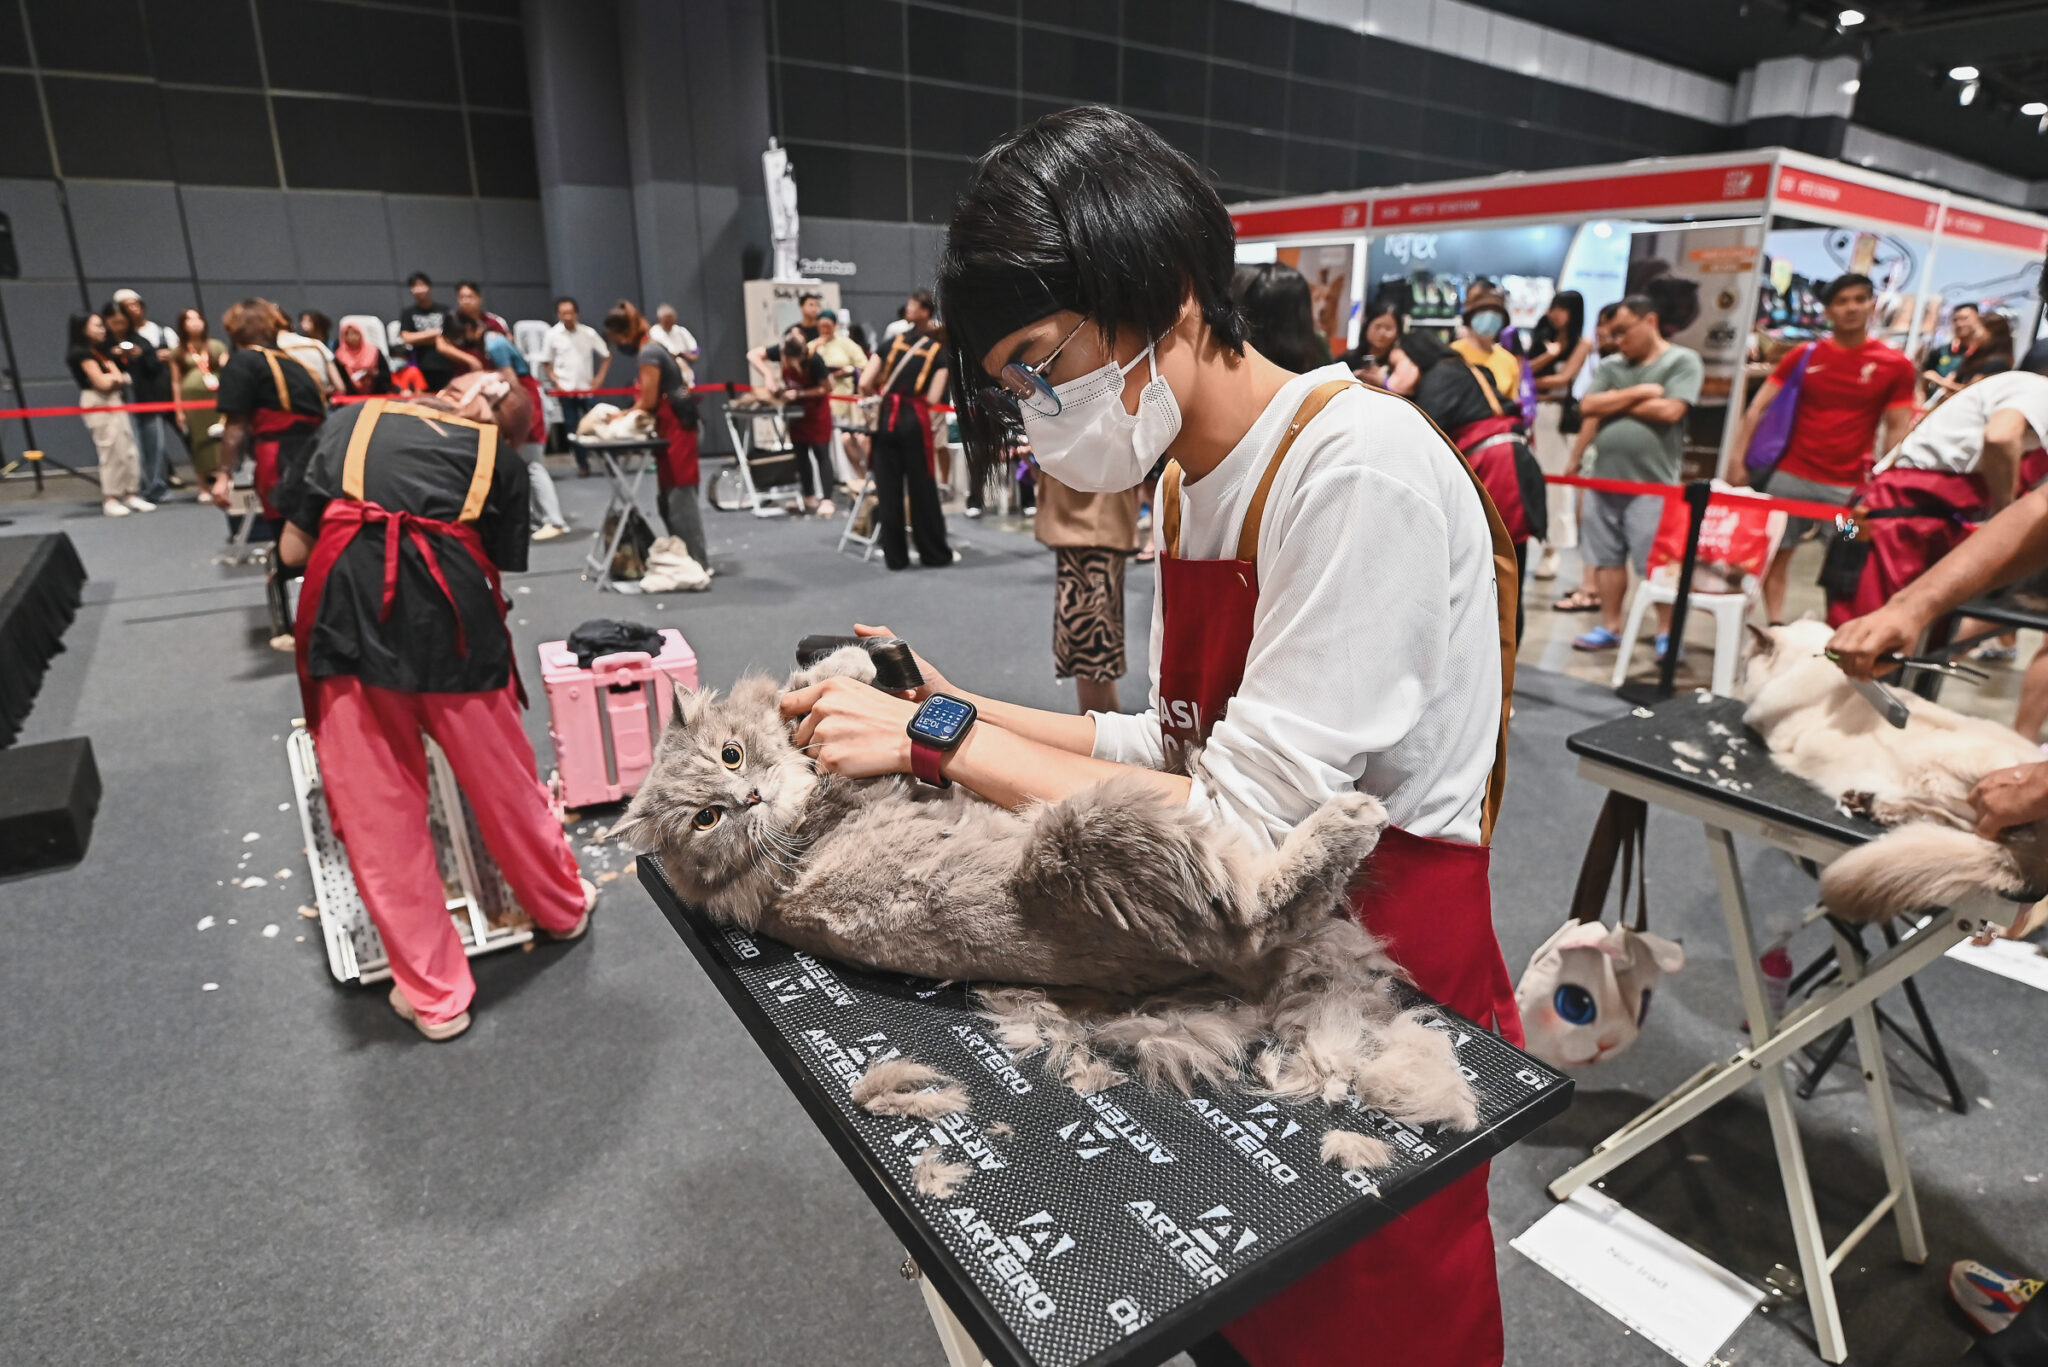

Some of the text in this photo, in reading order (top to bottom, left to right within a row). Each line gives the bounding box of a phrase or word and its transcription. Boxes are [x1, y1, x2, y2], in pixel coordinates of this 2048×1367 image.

[802, 1028, 862, 1088] ARTER
[952, 1024, 1031, 1095] ARTERO
[1190, 1098, 1300, 1186] ARTERO
[1347, 1095, 1437, 1159] ARTER
[951, 1206, 1056, 1320] ARTERO
[1128, 1200, 1228, 1286] ARTER
